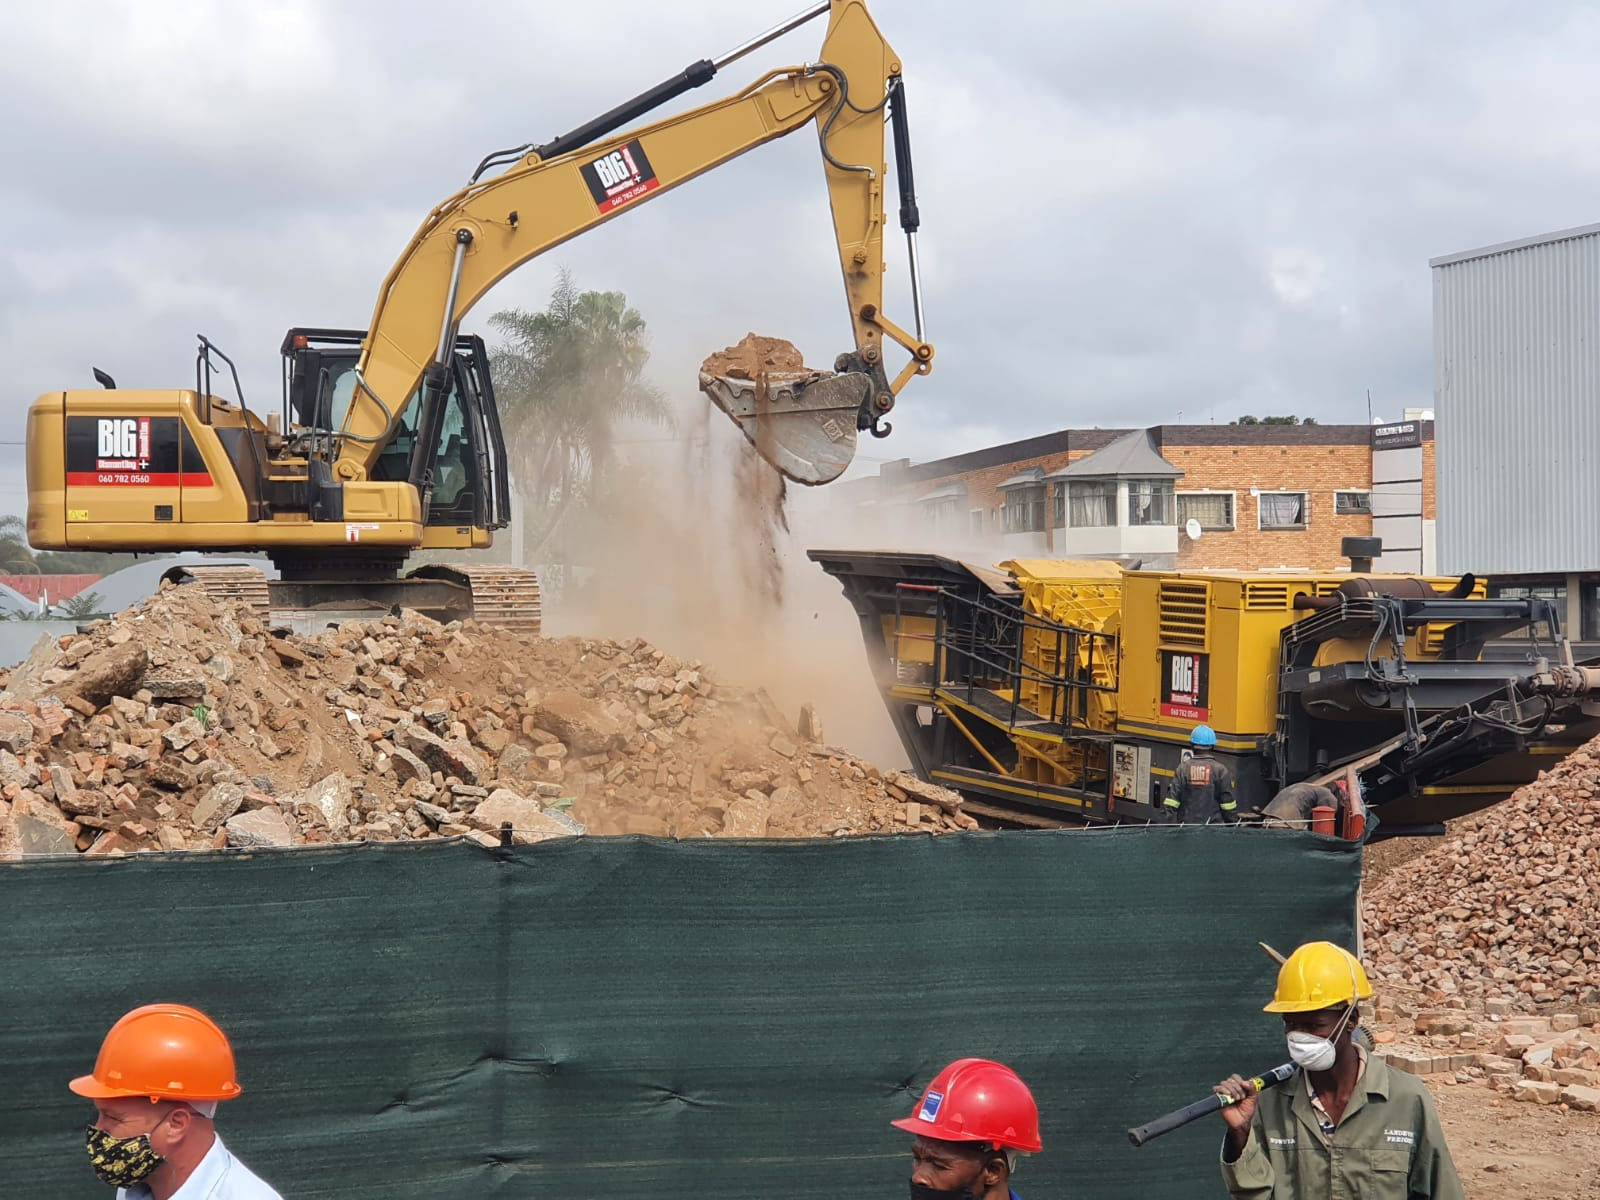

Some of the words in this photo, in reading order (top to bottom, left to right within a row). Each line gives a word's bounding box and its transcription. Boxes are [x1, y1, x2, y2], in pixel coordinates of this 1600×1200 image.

[593, 151, 631, 189] BIG
[98, 419, 137, 457] BIG
[98, 474, 112, 483] 060
[114, 474, 128, 483] 782
[131, 474, 150, 483] 0560
[1172, 655, 1193, 692] BIG
